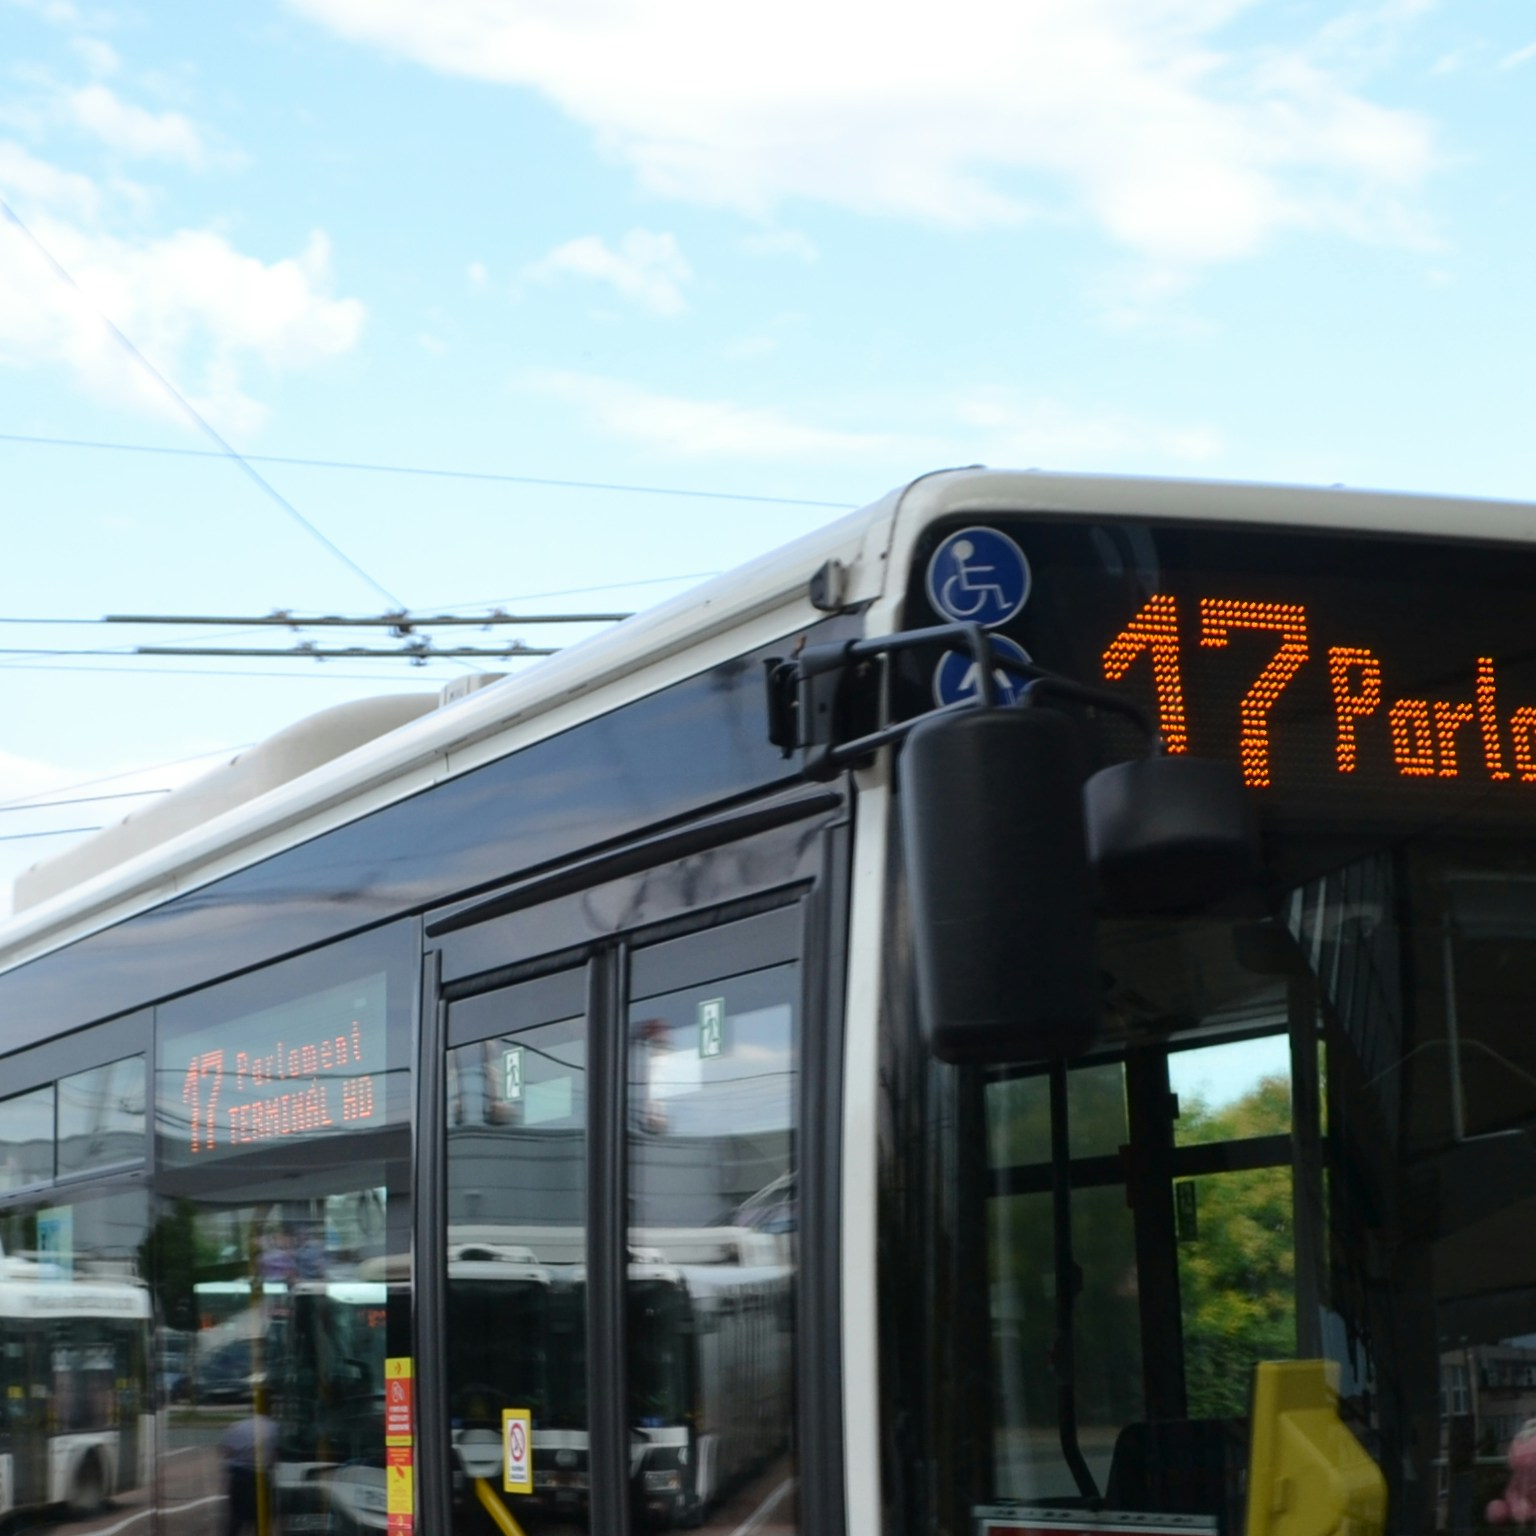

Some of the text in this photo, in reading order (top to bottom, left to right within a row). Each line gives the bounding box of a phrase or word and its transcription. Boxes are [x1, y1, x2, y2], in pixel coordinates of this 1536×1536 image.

[1102, 593, 1310, 788] 17
[181, 1048, 225, 1153] 17
[235, 1019, 362, 1091] Parlament
